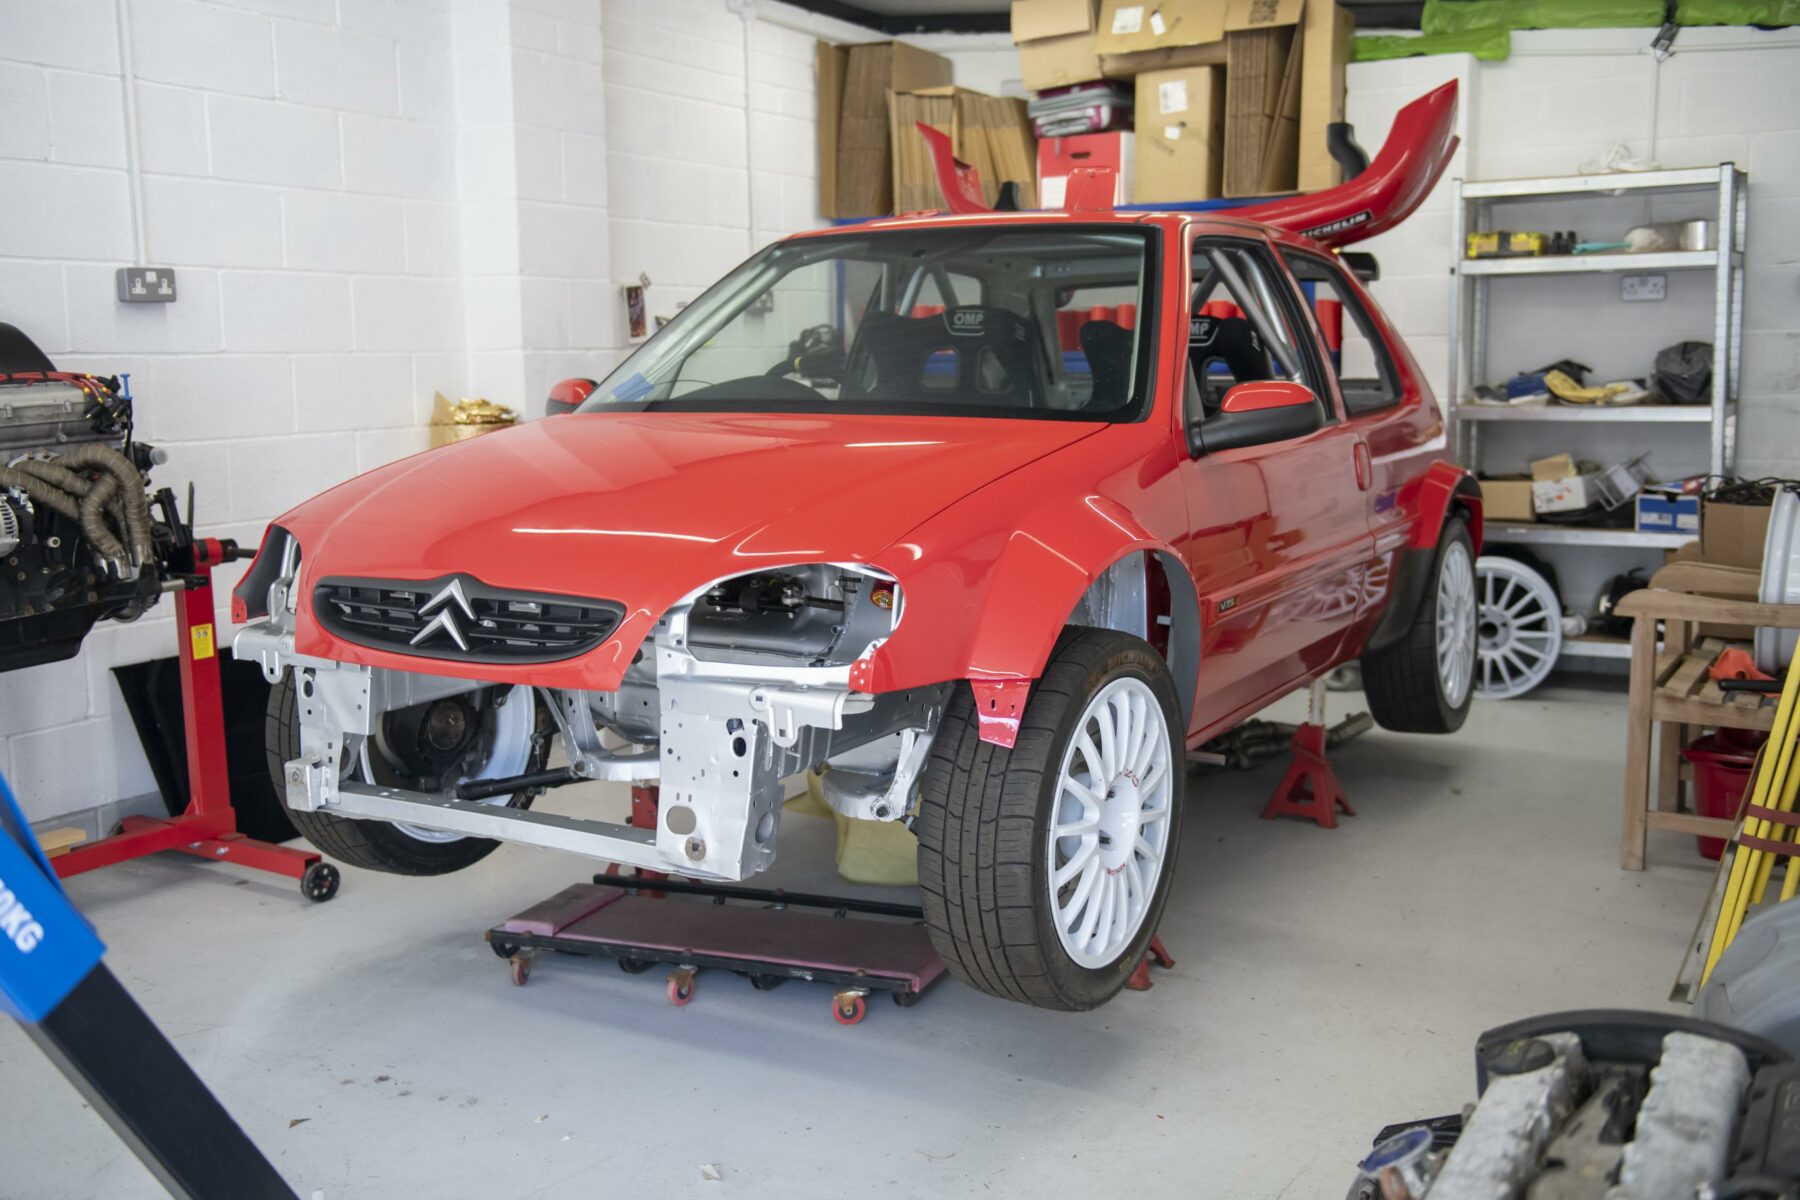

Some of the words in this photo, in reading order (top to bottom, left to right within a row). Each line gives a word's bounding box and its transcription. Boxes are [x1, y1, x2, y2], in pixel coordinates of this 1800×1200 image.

[953, 312, 984, 326] OMP
[1190, 322, 1209, 336] MP
[0, 878, 44, 953] 0KG
